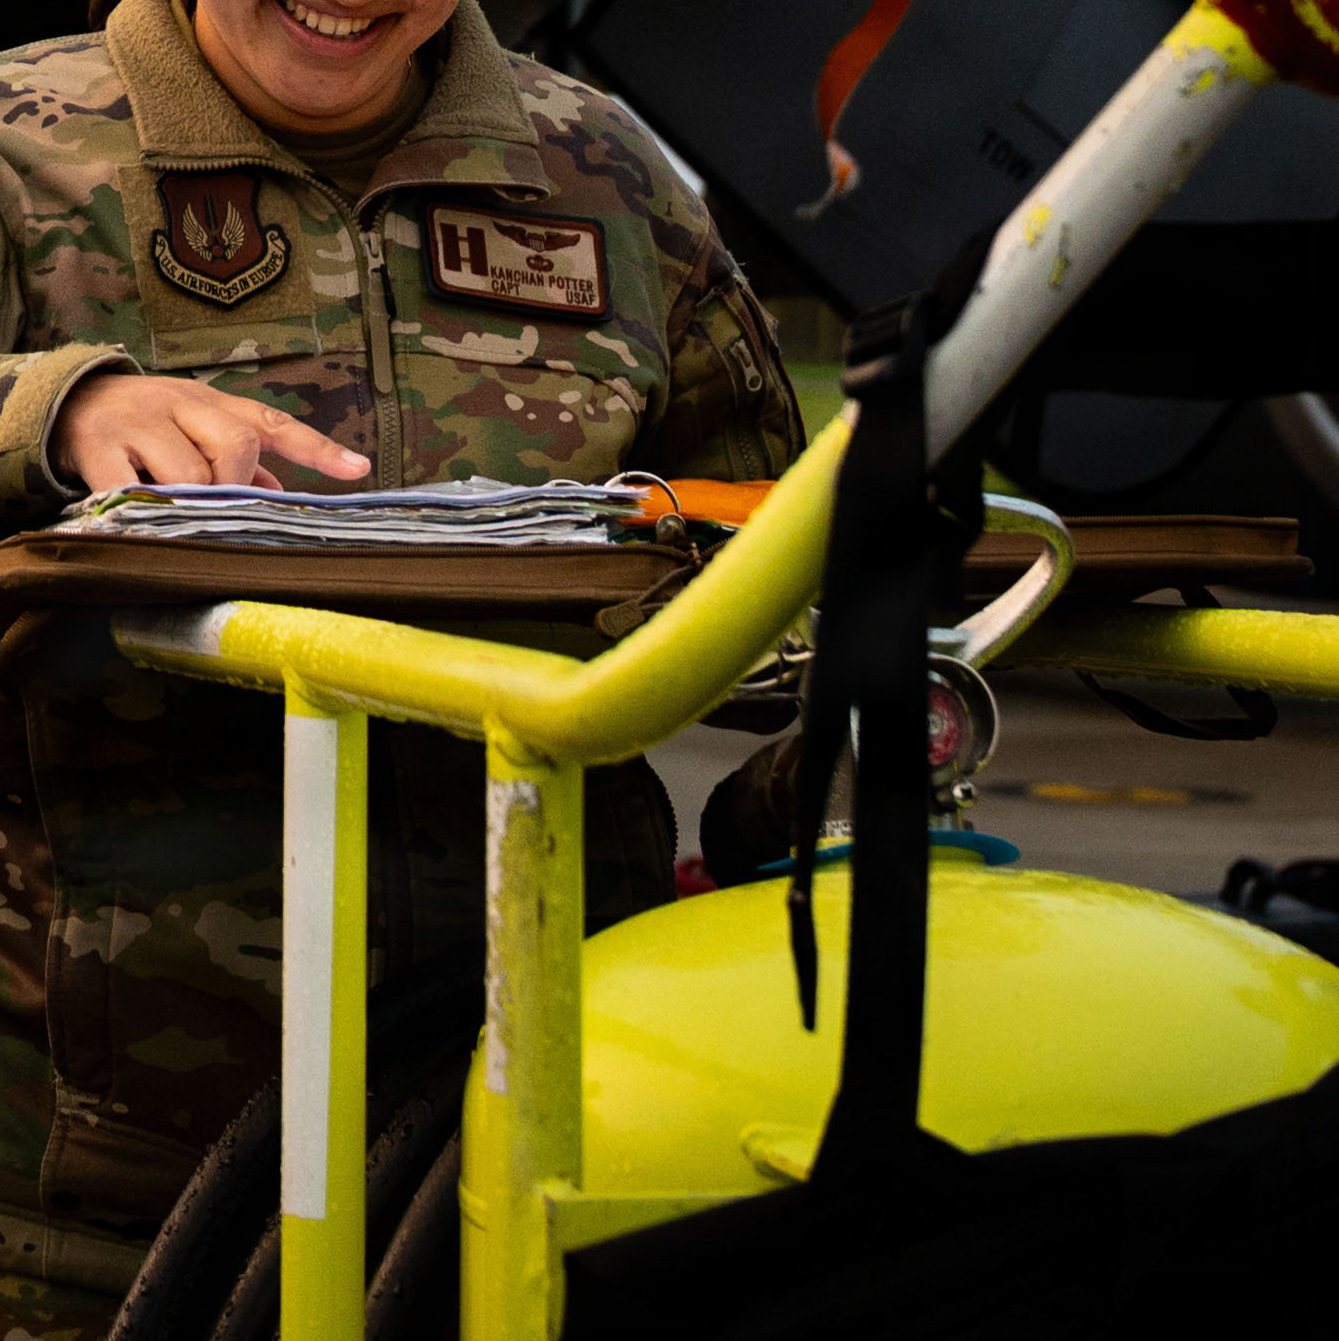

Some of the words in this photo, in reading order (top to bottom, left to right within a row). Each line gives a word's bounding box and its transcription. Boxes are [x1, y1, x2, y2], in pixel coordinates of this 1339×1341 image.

[177, 272, 198, 290] AIR
[198, 280, 240, 300] FORCES
[238, 276, 251, 292] IN
[248, 251, 281, 286] EUROPE
[548, 274, 594, 293] POTTER
[491, 279, 520, 296] CAPT
[565, 290, 596, 306] USAF
